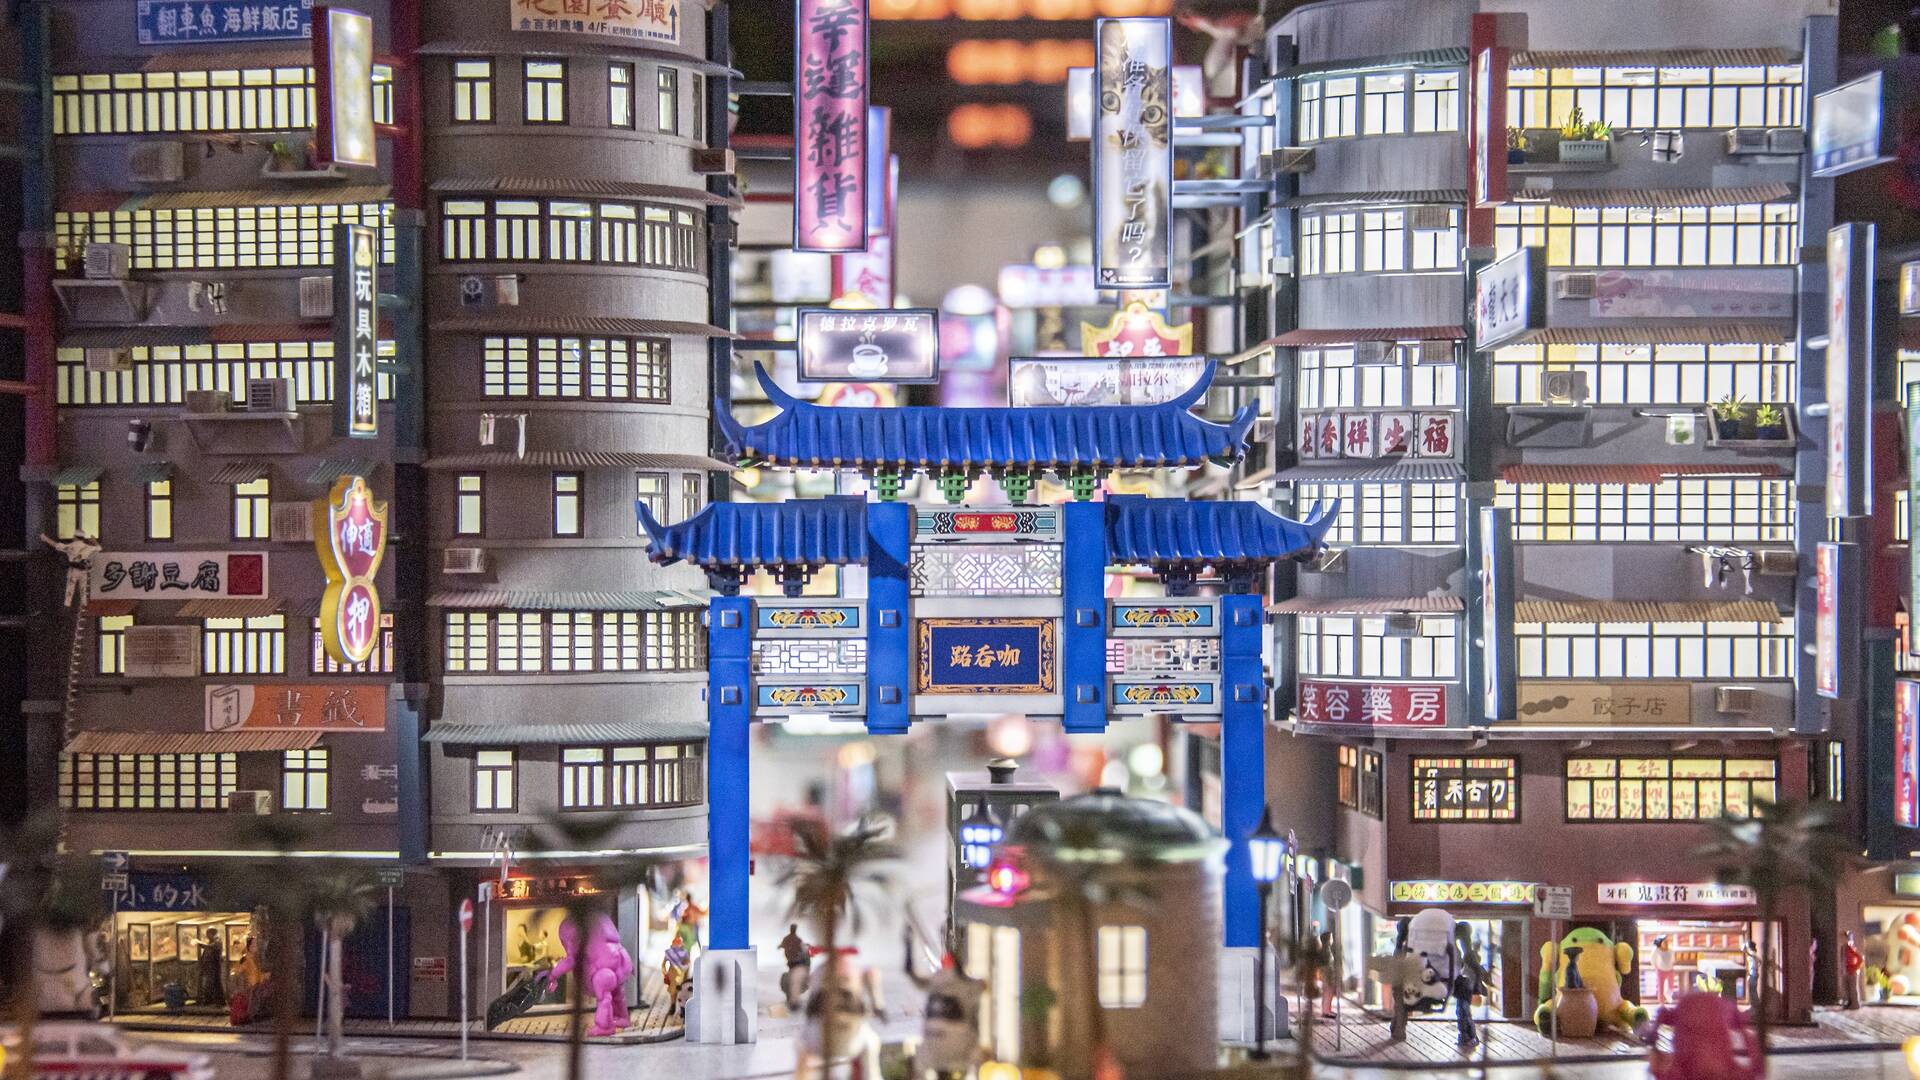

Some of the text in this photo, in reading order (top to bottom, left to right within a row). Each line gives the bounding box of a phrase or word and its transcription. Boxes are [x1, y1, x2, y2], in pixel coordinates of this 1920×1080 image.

[223, 5, 299, 33] 海鮮飯店
[804, 5, 864, 234] 幸運雜貨
[820, 316, 920, 332] 德拉克罗瓦
[355, 270, 372, 416] 玩具木箱
[100, 560, 220, 592] 多謝豆腐
[347, 591, 371, 644] 押
[1302, 684, 1441, 722] 笑容藥房
[1592, 697, 1667, 716] 餃子店
